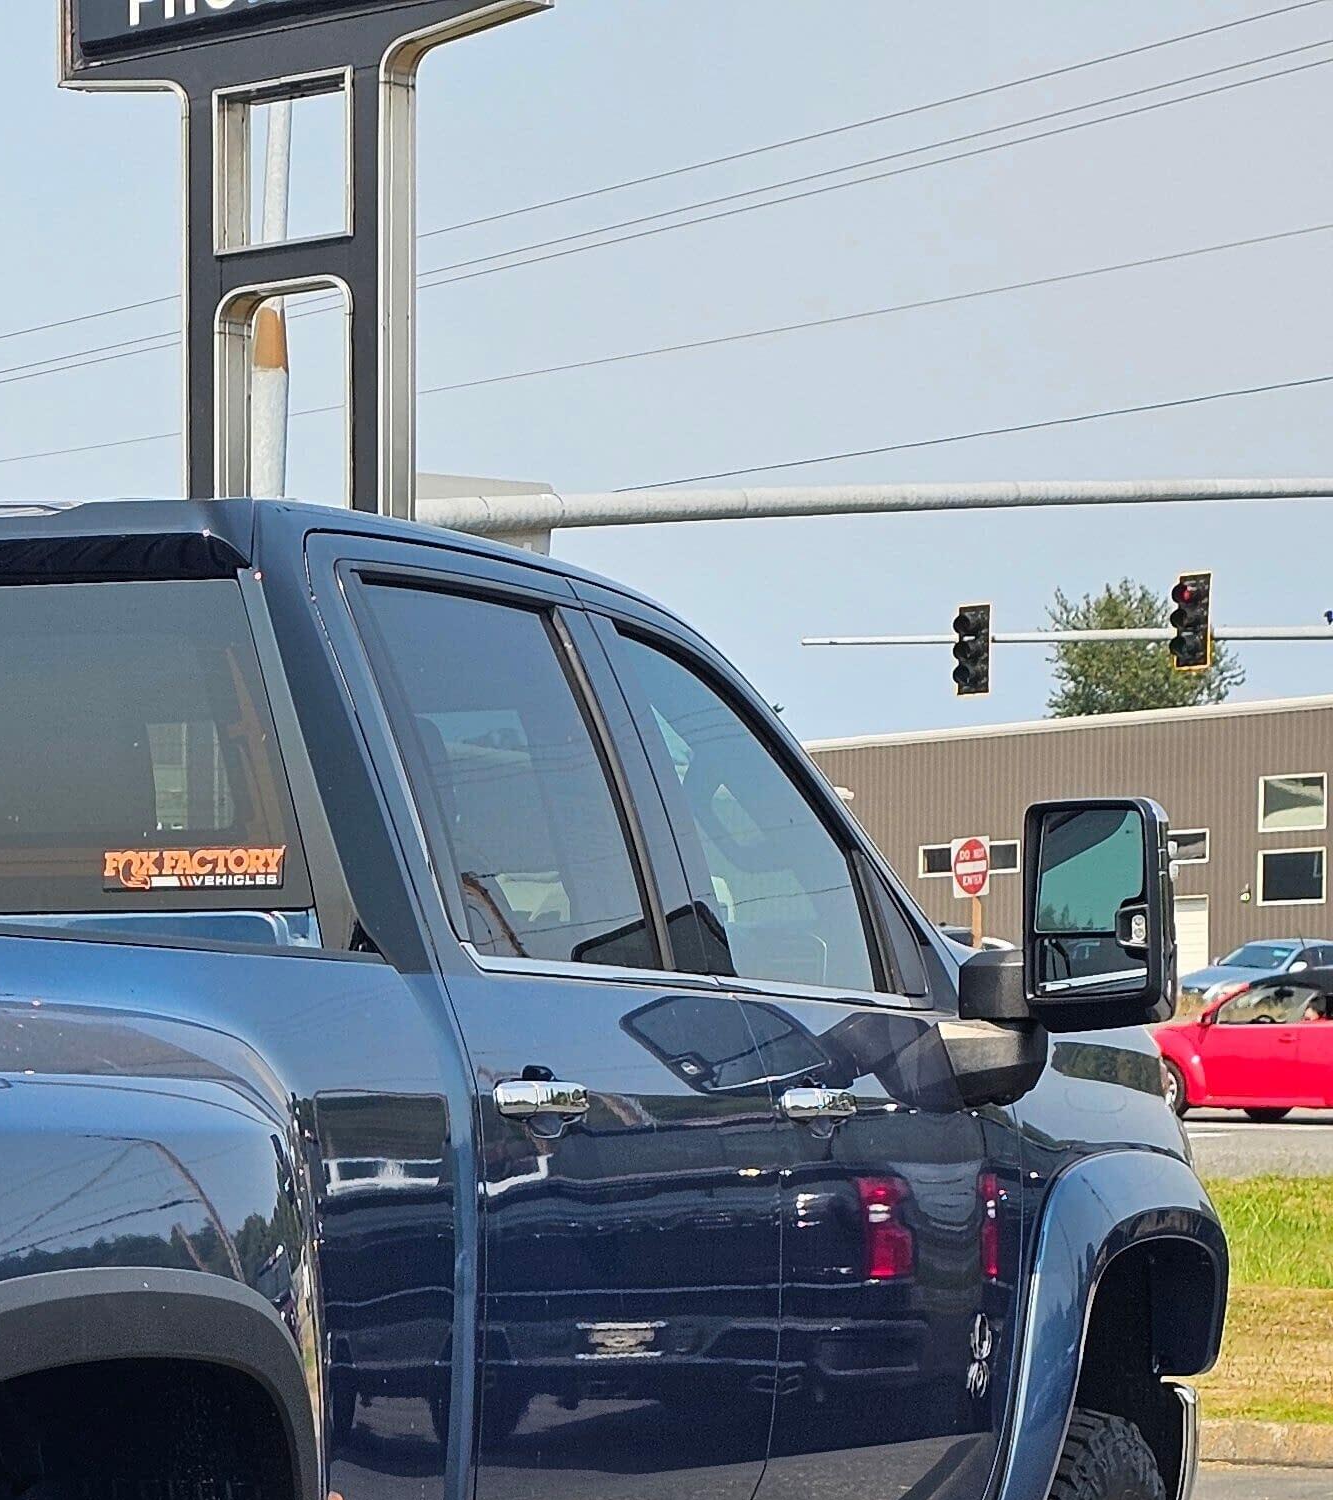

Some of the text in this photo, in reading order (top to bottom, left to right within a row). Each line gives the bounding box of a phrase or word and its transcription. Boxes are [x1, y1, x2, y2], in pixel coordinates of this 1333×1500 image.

[104, 847, 285, 888] FOX FACTORY
[192, 875, 278, 886] VEHICLES
